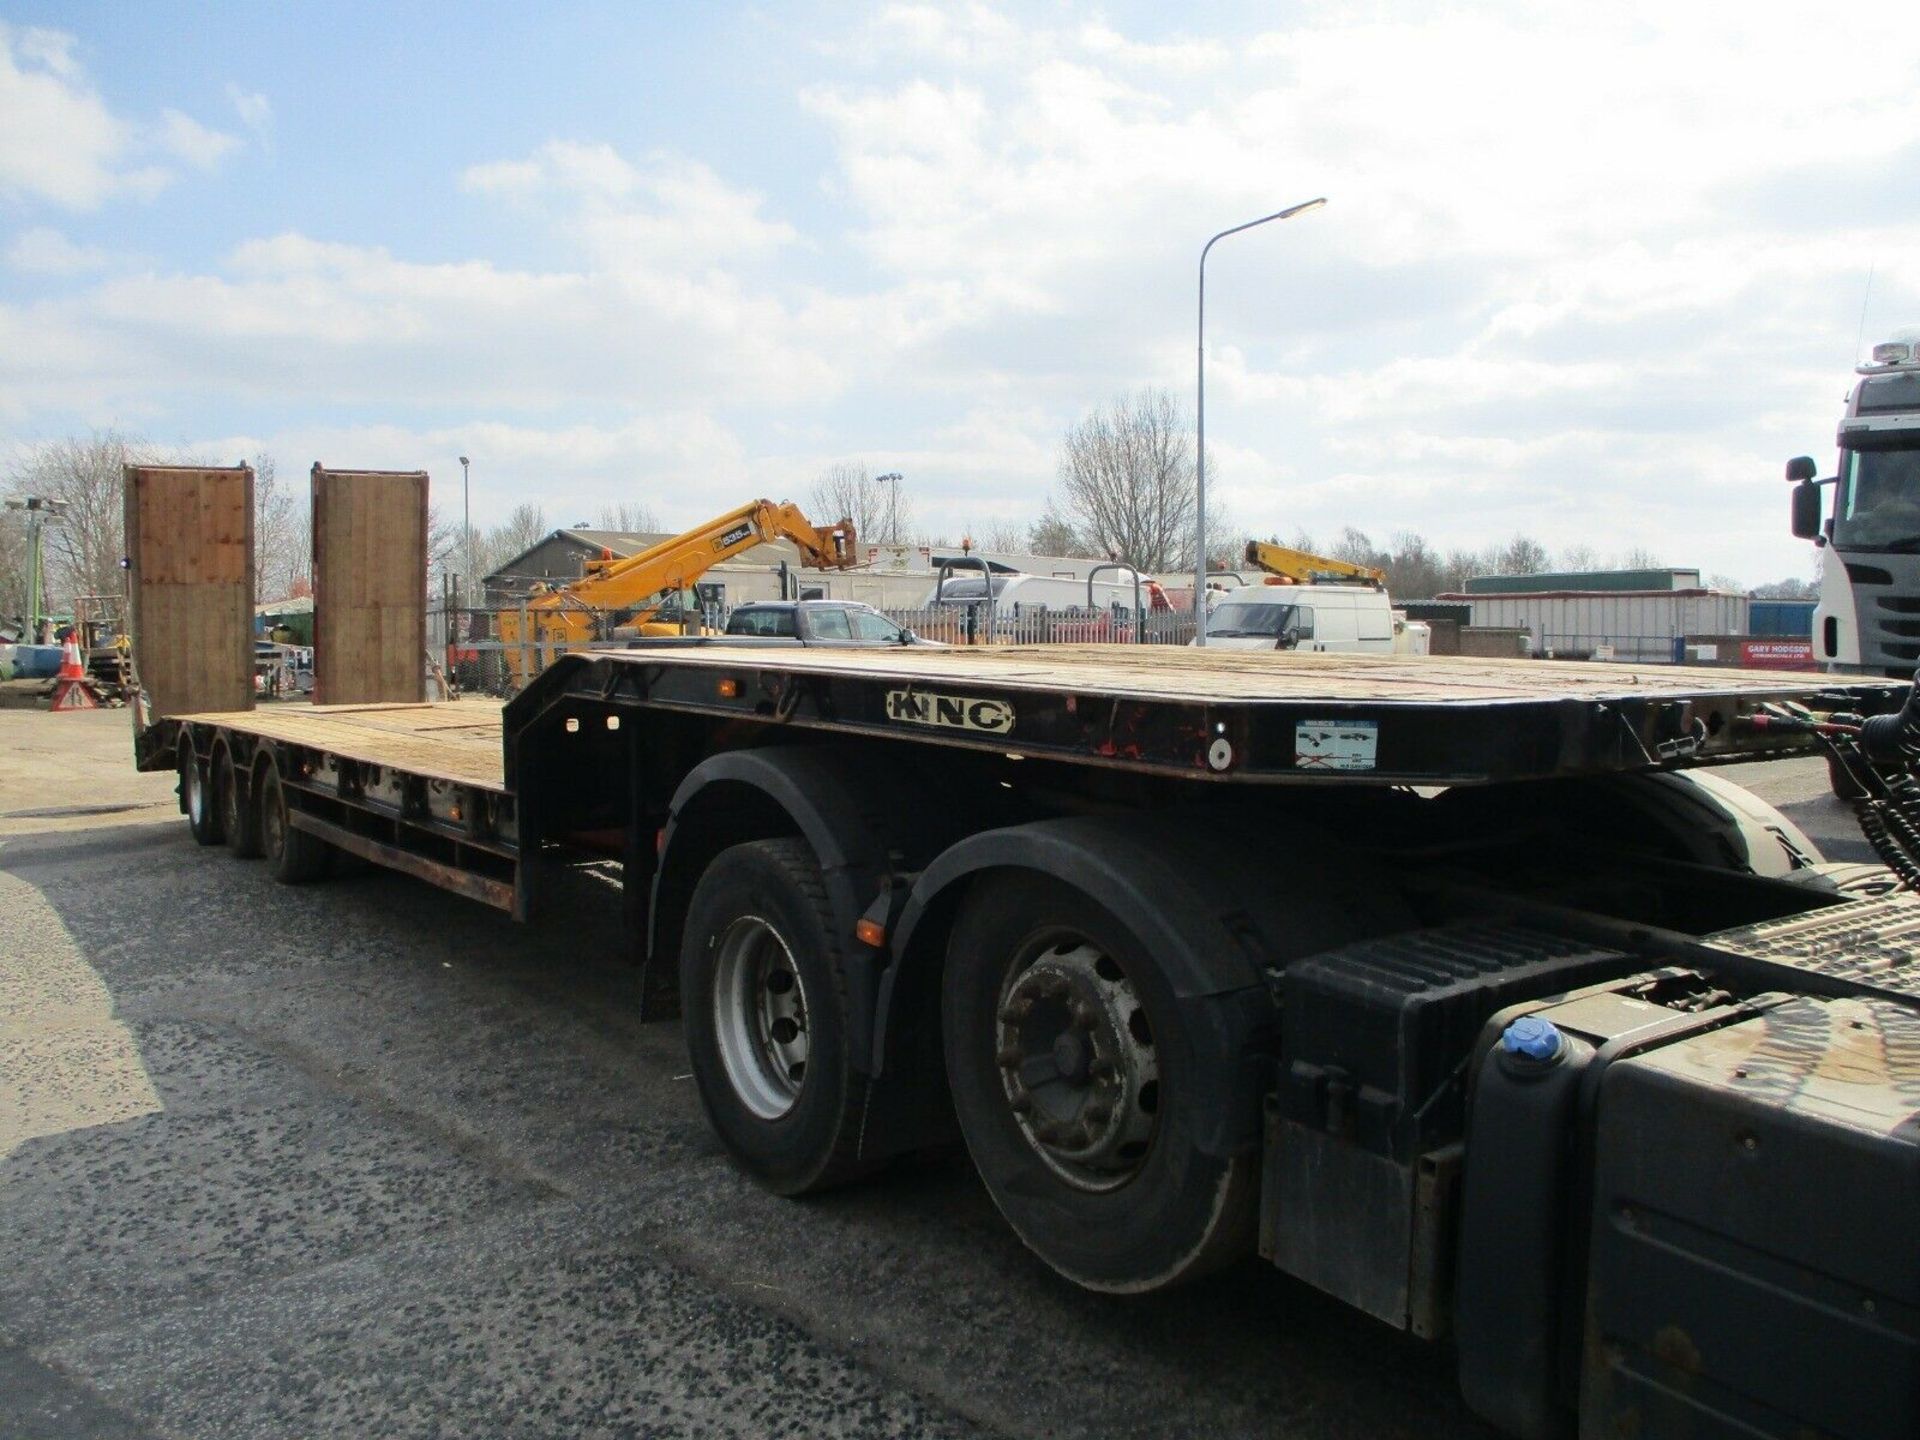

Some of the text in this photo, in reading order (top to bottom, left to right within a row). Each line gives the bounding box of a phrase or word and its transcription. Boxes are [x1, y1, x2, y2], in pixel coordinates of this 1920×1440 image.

[1748, 645, 1811, 654] GARY HODGSON
[892, 692, 1005, 730] KING
